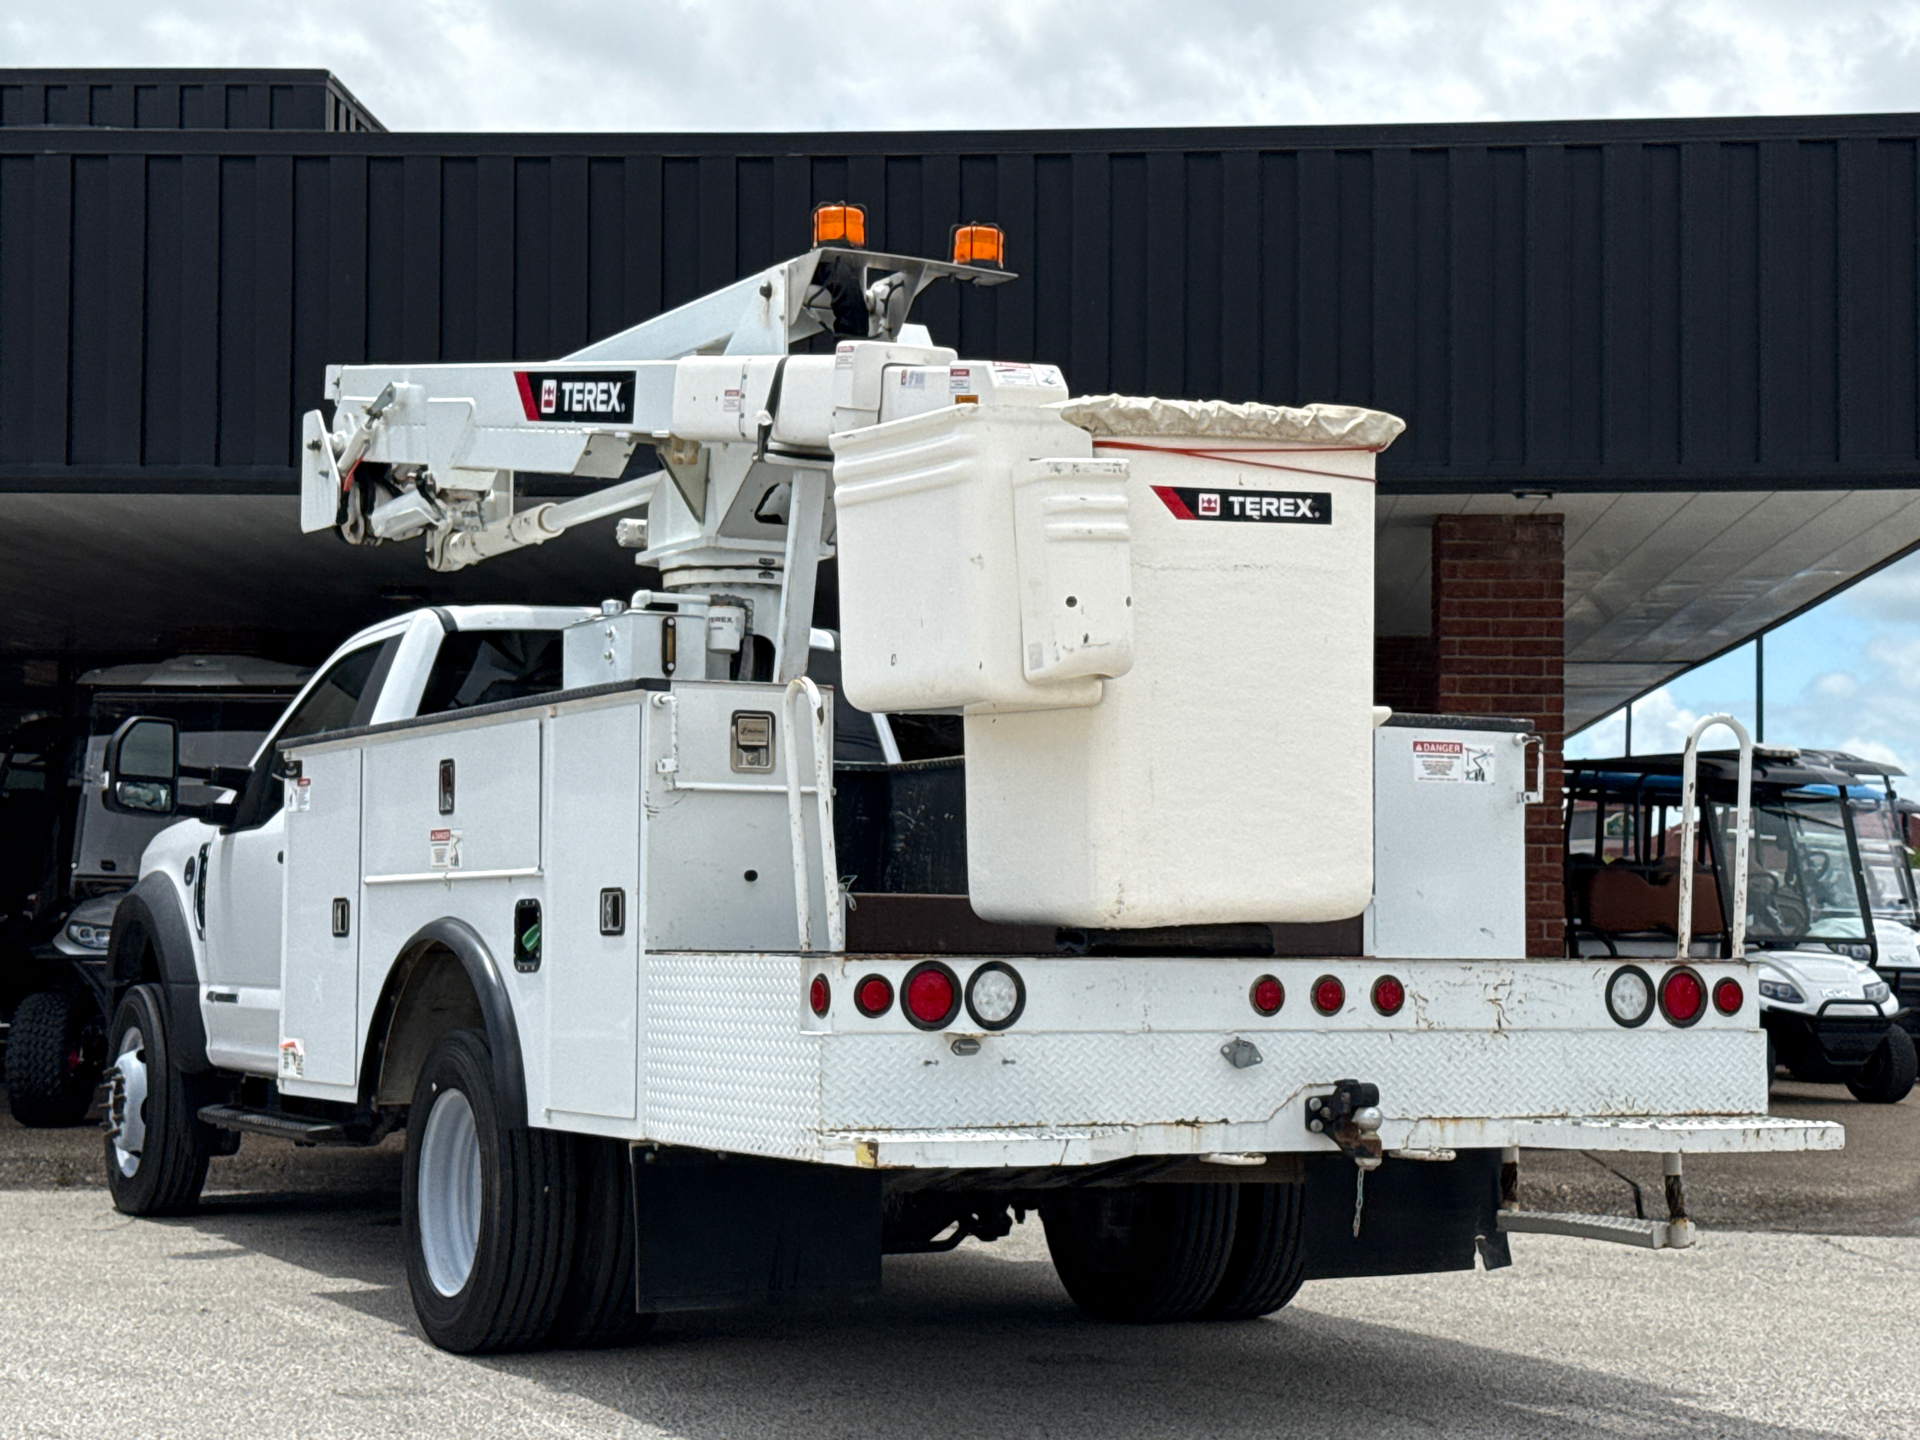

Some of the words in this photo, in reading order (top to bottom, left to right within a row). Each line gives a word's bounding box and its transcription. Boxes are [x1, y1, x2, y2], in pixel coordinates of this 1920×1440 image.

[561, 381, 622, 413] TEREX
[1228, 495, 1314, 519] TEREX
[1423, 742, 1461, 753] DANGER
